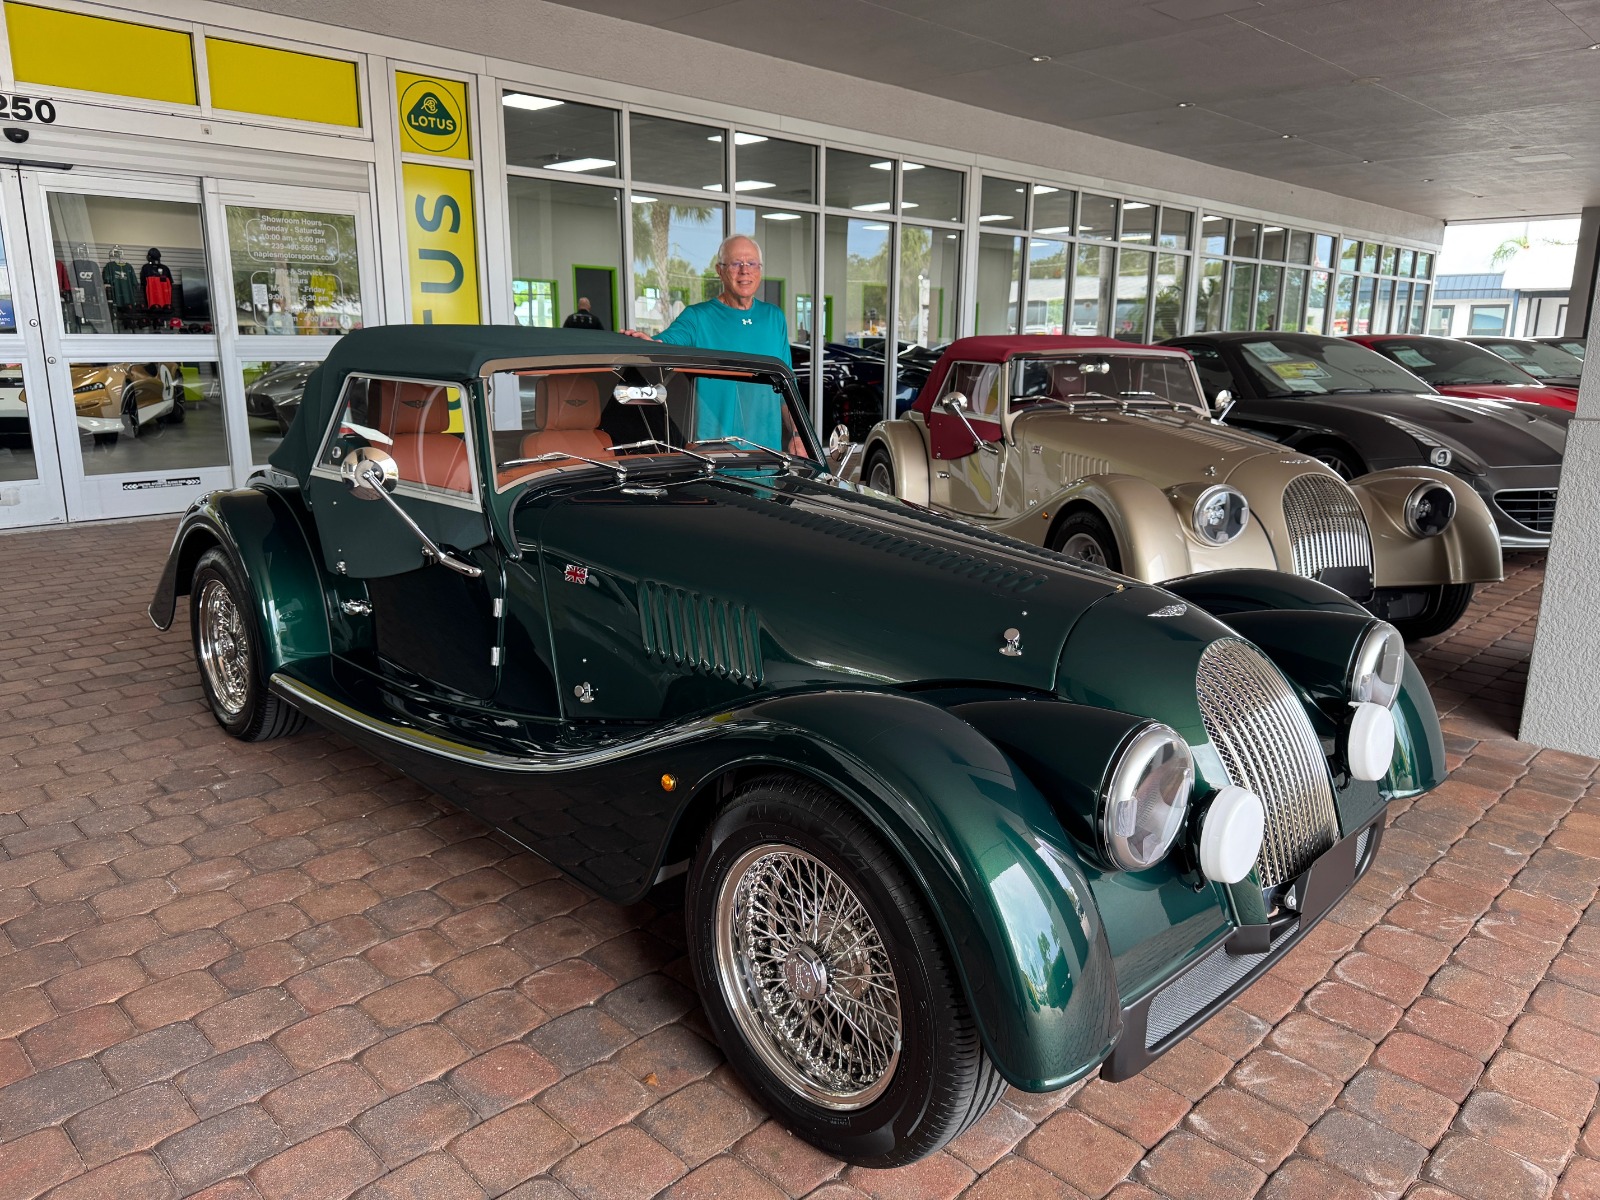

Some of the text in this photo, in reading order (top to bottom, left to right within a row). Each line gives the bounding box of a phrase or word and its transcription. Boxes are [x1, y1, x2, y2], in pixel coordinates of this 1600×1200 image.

[411, 114, 454, 131] LOTUS
[261, 215, 323, 227] Showroom Hours
[260, 224, 289, 233] Monday
[294, 226, 326, 237] Saturday
[315, 237, 327, 245] pm
[253, 250, 336, 262] naplesmotorsports.com
[297, 268, 323, 277] Service
[304, 285, 326, 295] Friday
